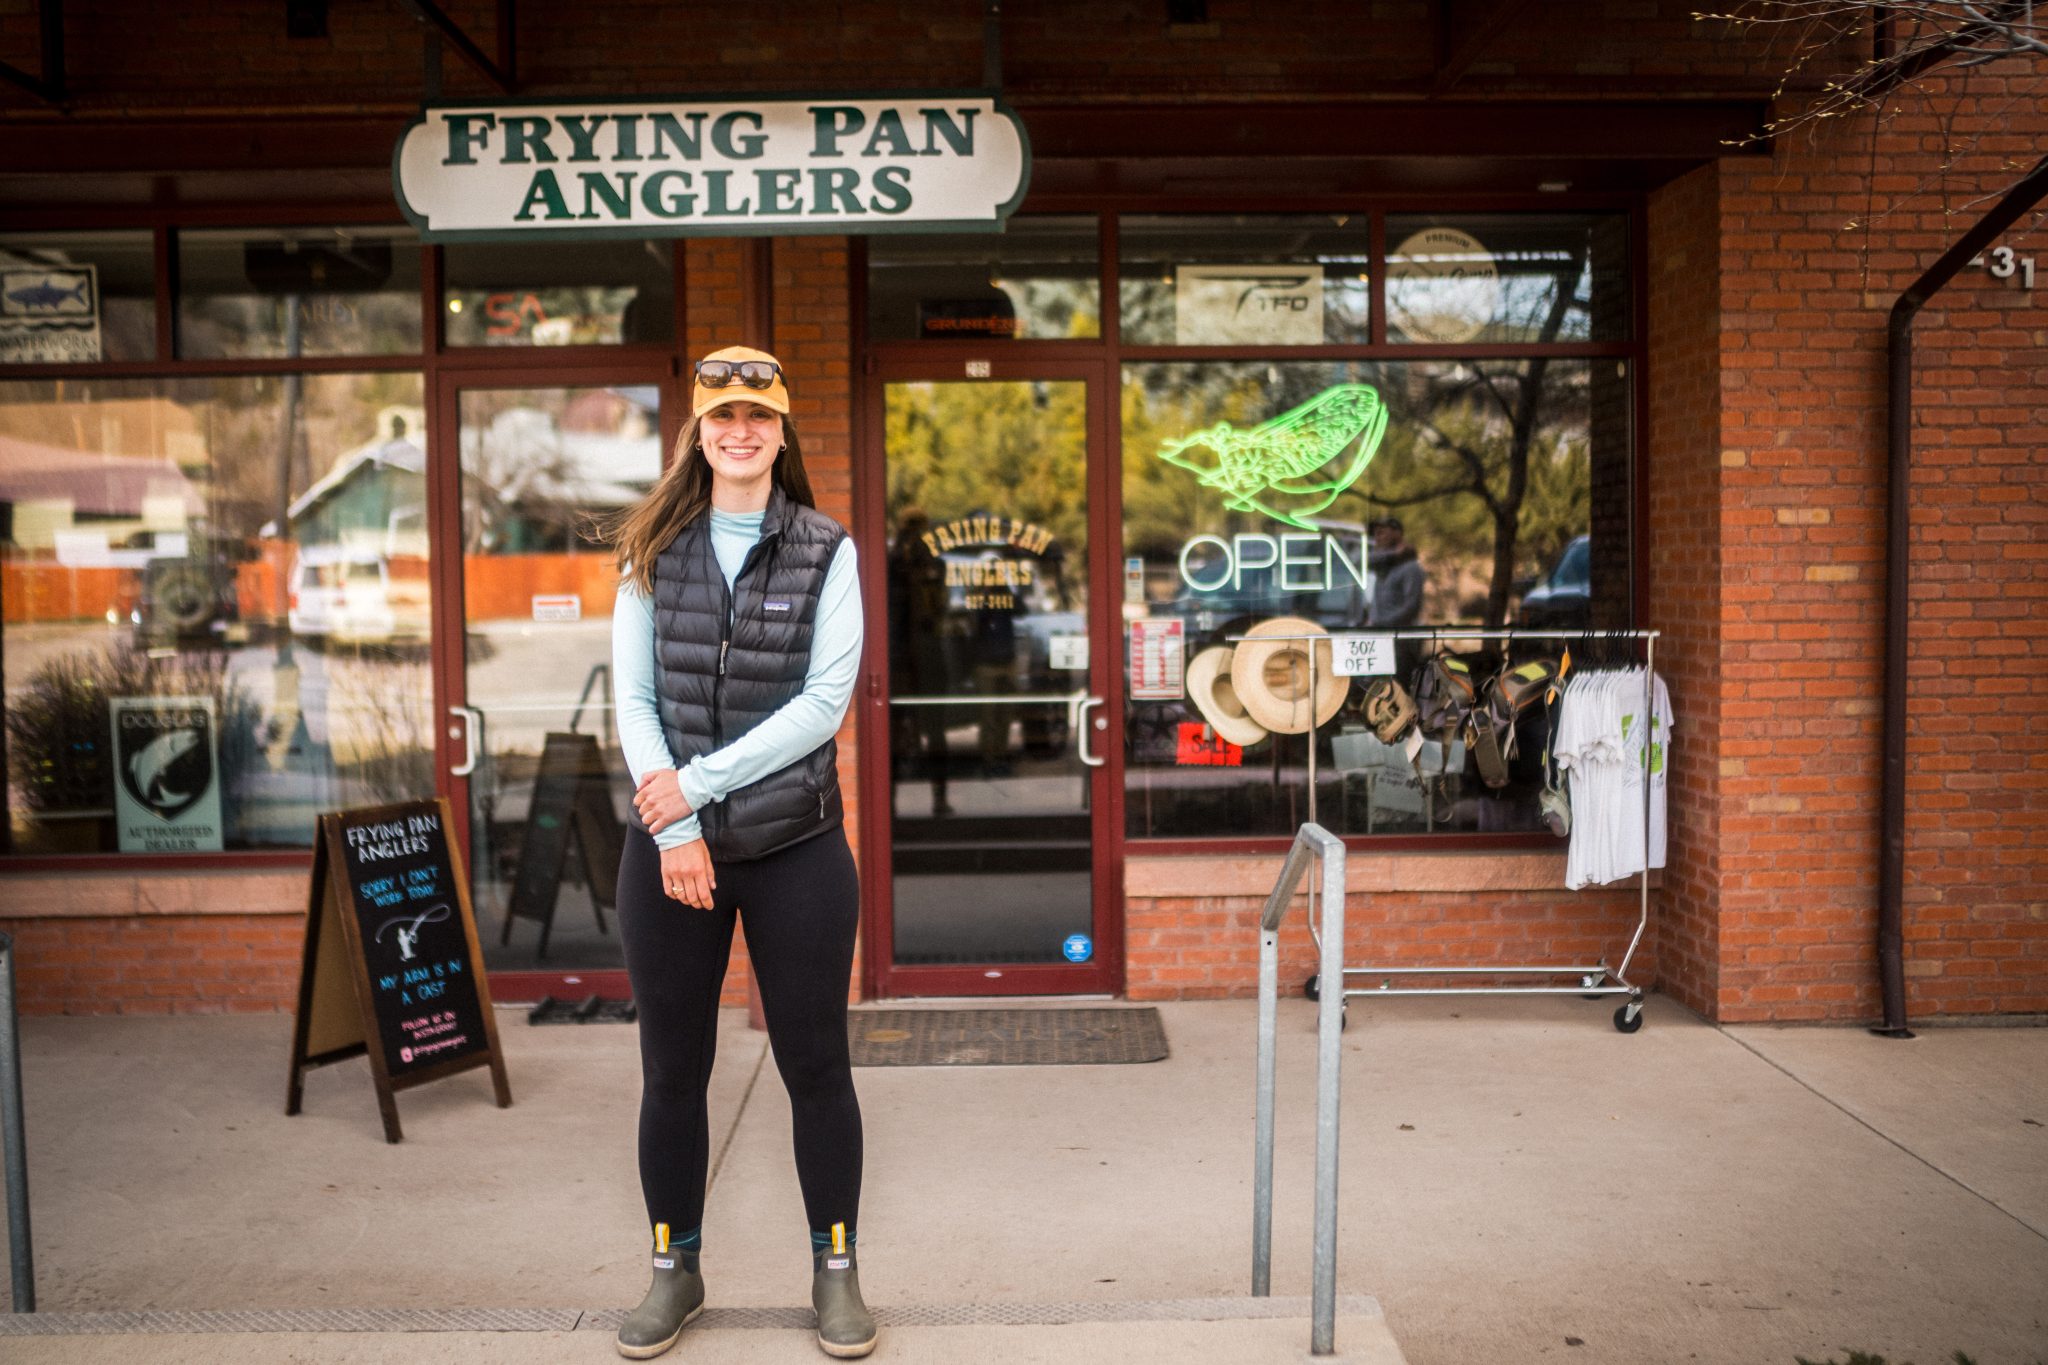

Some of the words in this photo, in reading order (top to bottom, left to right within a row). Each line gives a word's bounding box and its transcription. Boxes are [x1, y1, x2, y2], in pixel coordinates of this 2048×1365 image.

[441, 111, 769, 165] FRYING
[808, 106, 980, 158] PAN
[513, 166, 913, 221] ANGLERS
[1424, 233, 1471, 248] PREMIUM
[1967, 246, 2035, 288] 31
[1256, 296, 1309, 312] TFO
[921, 517, 1001, 558] FRYING
[1007, 519, 1054, 556] PAN
[945, 560, 1032, 587] ANGLERS
[1180, 533, 1367, 592] OPEN
[1348, 639, 1376, 656] 30%
[1345, 657, 1378, 672] OFF
[121, 711, 206, 729] DOUGLAS
[346, 820, 405, 848] FRYING
[407, 814, 439, 836] PAN
[358, 835, 429, 863] ANGLERS
